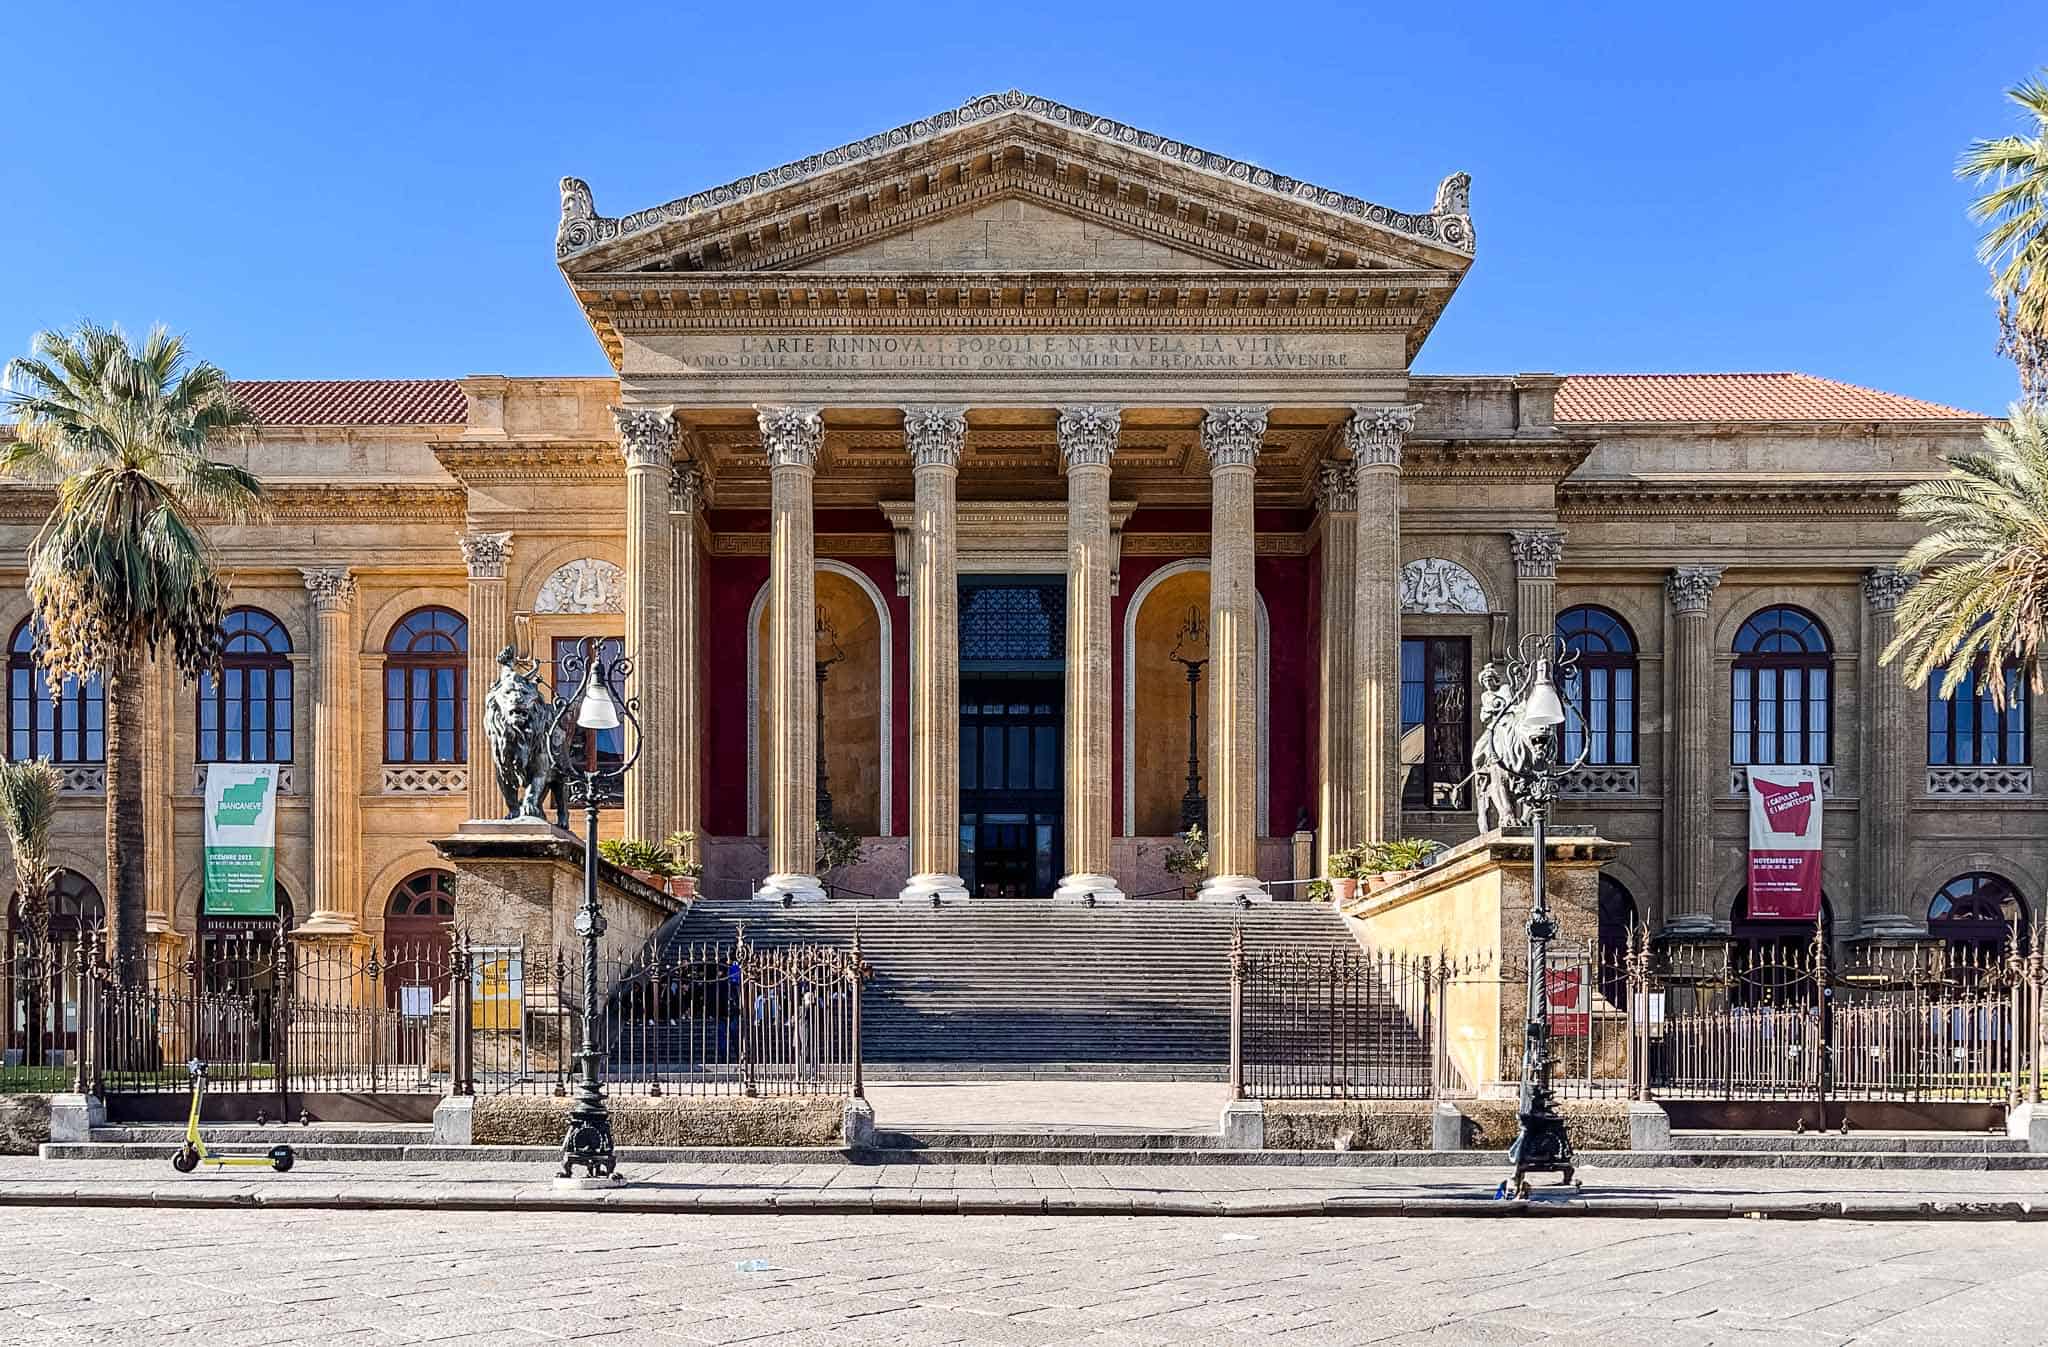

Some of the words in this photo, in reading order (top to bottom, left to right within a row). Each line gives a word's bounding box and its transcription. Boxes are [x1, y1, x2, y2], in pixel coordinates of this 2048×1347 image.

[740, 337, 815, 353] L'ARTE
[828, 337, 925, 353] RINNOVA
[938, 337, 943, 353] I
[957, 337, 1032, 353] POPOLI
[1045, 337, 1056, 353] E
[1068, 337, 1097, 353] NE
[1109, 337, 1185, 353] RIVELA
[1200, 337, 1225, 353] LA
[1236, 337, 1286, 353] VITA
[681, 354, 729, 367] VANO
[740, 354, 786, 367] DELLE
[800, 354, 859, 367] SCENE
[871, 354, 888, 367] IL
[899, 354, 969, 367] DILETTO
[983, 354, 1016, 367] OVE
[1028, 354, 1065, 367] NON
[1080, 354, 1119, 367] MIRI
[1130, 354, 1140, 367] A
[1150, 354, 1240, 367] PREPARAR
[1250, 354, 1347, 367] L'AVVENIRE
[207, 920, 277, 929] BIGLIETTERI
